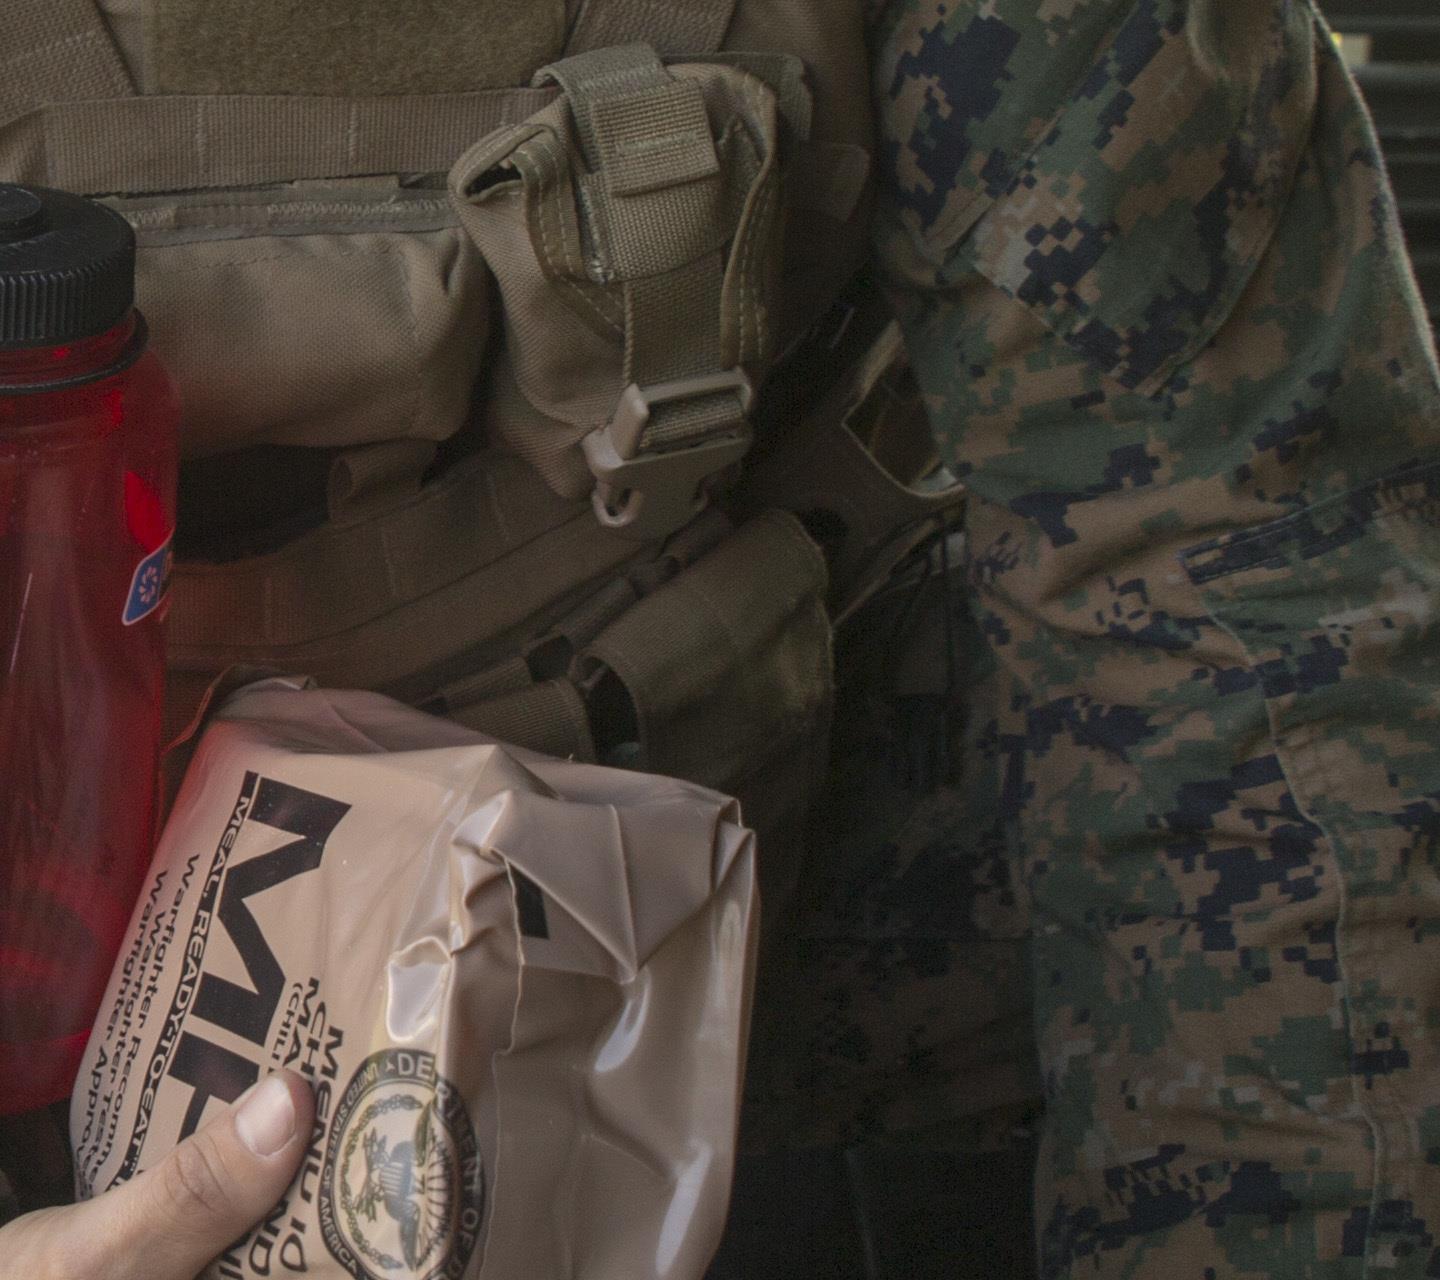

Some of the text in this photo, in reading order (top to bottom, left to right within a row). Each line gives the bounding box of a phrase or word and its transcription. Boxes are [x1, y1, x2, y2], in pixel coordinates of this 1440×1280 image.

[202, 796, 251, 898] MEAL,
[76, 870, 170, 1168] Warfighter Approv
[109, 910, 166, 1085] Warfighter
[138, 854, 201, 1030] Warfighter
[86, 1036, 142, 1192] Recomme
[300, 1025, 344, 1204] MENU
[319, 1196, 358, 1276] AMERICA
